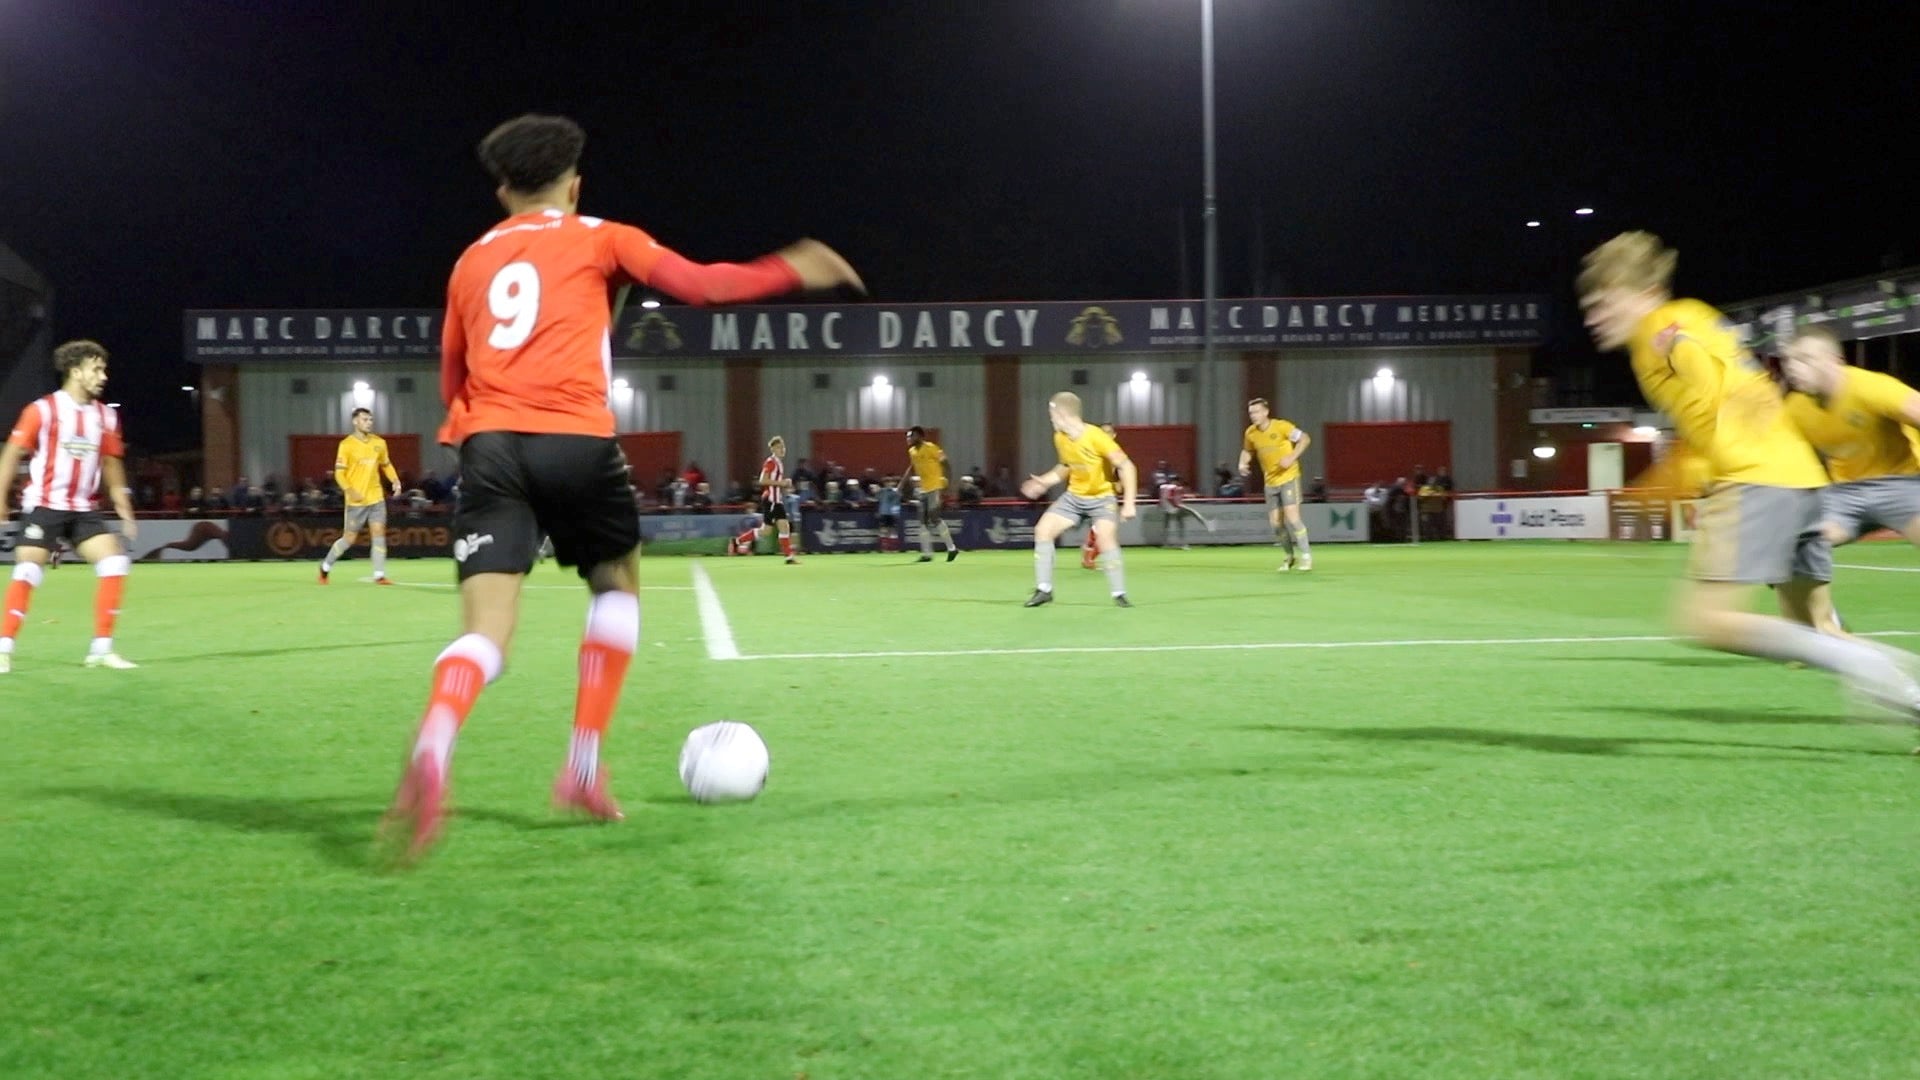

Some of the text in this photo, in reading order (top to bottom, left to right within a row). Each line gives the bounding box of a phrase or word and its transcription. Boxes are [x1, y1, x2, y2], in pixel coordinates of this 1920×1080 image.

[488, 261, 541, 350] 9
[1150, 303, 1539, 330] MAC DARCY MENSWEAR
[197, 316, 432, 340] MARC DARCY
[711, 309, 1039, 350] MARC DARCY
[301, 526, 449, 547] vaaama
